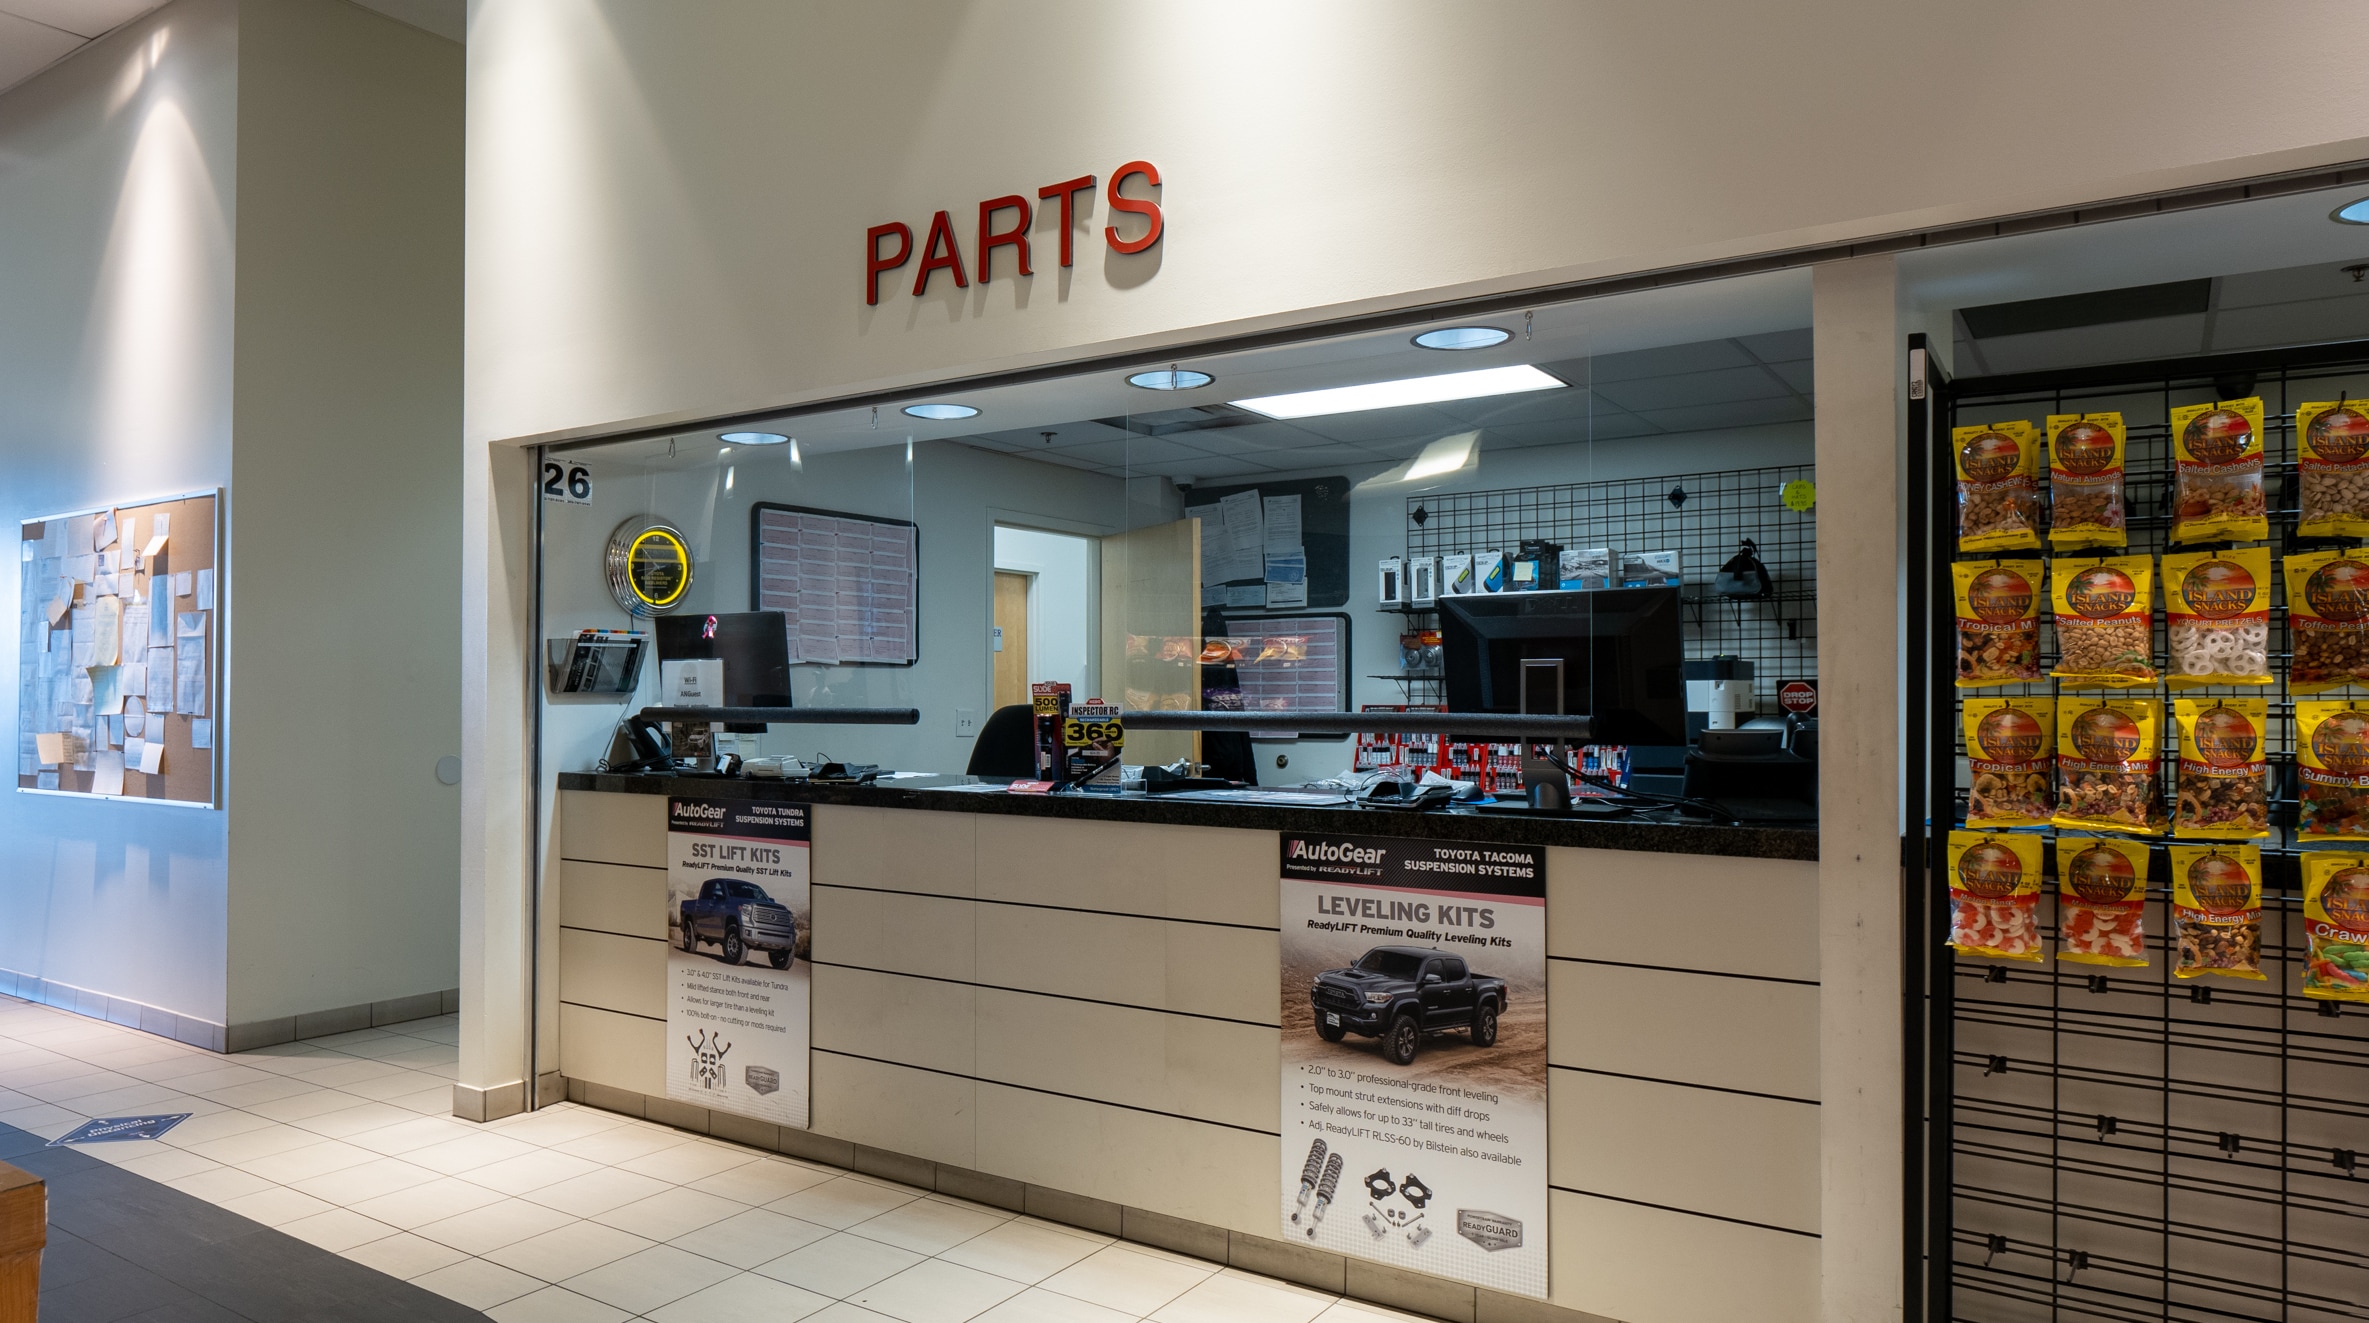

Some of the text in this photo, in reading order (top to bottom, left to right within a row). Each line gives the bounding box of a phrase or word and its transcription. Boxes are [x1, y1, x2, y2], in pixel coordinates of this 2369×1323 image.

[866, 160, 1165, 305] PARTS
[2059, 448, 2112, 459] ISLAND
[2193, 448, 2243, 458] SNACKS
[2063, 457, 2107, 467] SNACKS
[2178, 457, 2261, 474] Salted Cashews
[2303, 461, 2332, 471] Salted
[2051, 471, 2122, 483] Natural Almonds
[2071, 593, 2131, 603] ISLAND
[2188, 589, 2253, 601] ISLAND
[1973, 597, 2029, 607] ISLAND
[2076, 602, 2126, 612] SNACKS
[2193, 601, 2246, 611] SNACKS
[1978, 607, 2024, 616] SNACKS
[1959, 619, 2015, 632] Tropical
[2059, 616, 2142, 626] Salted Peanuts
[2177, 616, 2263, 627] YOGURT PRETZELS
[2298, 619, 2336, 630] Toffee
[1036, 698, 1058, 706] 500
[1072, 707, 1119, 715] INSPECTOR RC
[1067, 723, 1123, 741] 360
[2077, 735, 2137, 748] ISLAND
[2200, 737, 2253, 748] ISLAND
[2082, 746, 2131, 757] SNACKS
[2204, 749, 2249, 758] SNACKS
[1969, 759, 2027, 772] Tropical
[2062, 758, 2149, 773] High Energy Mix
[2183, 761, 2249, 776] High Energy
[2303, 768, 2354, 787] Gummy
[674, 803, 726, 819] AutoGear
[752, 806, 776, 815] TOYOTA
[736, 816, 773, 825] SUSPENSION
[692, 843, 780, 864] SST LIFT KITS
[1292, 840, 1386, 864] AutoGear
[1434, 848, 1534, 864] TOYOTA TACOMA
[682, 861, 710, 870] ReadyLIFT
[711, 864, 734, 872] Premium
[736, 866, 754, 875] Quality
[1286, 864, 1309, 872] Presented
[1319, 866, 1383, 876] READYLIFT
[1404, 860, 1534, 878] SUSPENSION SYSTEMS
[2195, 885, 2249, 896] ISLAND
[1960, 893, 1987, 905] Melon
[2072, 899, 2130, 912] Melon Rings
[2200, 896, 2244, 906] SNACKS
[1318, 895, 1495, 929] LEVELING KITS
[2183, 909, 2244, 925] High Energy
[1307, 919, 1512, 947] ReadyLIFT Premium Quality Leveling Kits
[712, 972, 722, 980] SST
[731, 975, 740, 983] Kits
[741, 977, 762, 987] available
[762, 980, 770, 988] for
[771, 982, 788, 991] Tundra
[697, 984, 709, 992] lifted
[709, 986, 724, 995] stance
[725, 988, 737, 996] both
[737, 990, 749, 999] front
[750, 992, 759, 1000] and
[687, 996, 702, 1004] Allows
[710, 999, 723, 1008] larger
[725, 1001, 733, 1009] tire
[733, 1003, 744, 1011] than
[749, 1006, 768, 1017] leveling
[686, 1009, 700, 1017] 100%
[701, 1011, 717, 1020] bolt-on
[727, 1017, 744, 1027] cutting
[751, 1020, 764, 1030] mods
[765, 1024, 786, 1033] required
[1327, 1068, 1336, 1077] to
[1357, 1073, 1437, 1094] professional-grade
[1439, 1085, 1461, 1097] front
[1463, 1088, 1499, 1105] leveling
[1309, 1083, 1490, 1122] Top mount strut extensions with diff drops
[1309, 1101, 1334, 1114] Safely
[1335, 1106, 1362, 1119] allows
[1363, 1109, 1376, 1121] for
[1378, 1113, 1390, 1125] up
[1391, 1115, 1400, 1124] to
[1420, 1119, 1433, 1130] tall
[1435, 1122, 1455, 1135] tires
[1456, 1126, 1475, 1137] and
[1476, 1130, 1509, 1143] wheels
[1309, 1121, 1522, 1166] Adj. ReadyLIFT RLSS-60 by Bilstein also available
[1463, 1222, 1518, 1238] READYGUARD
